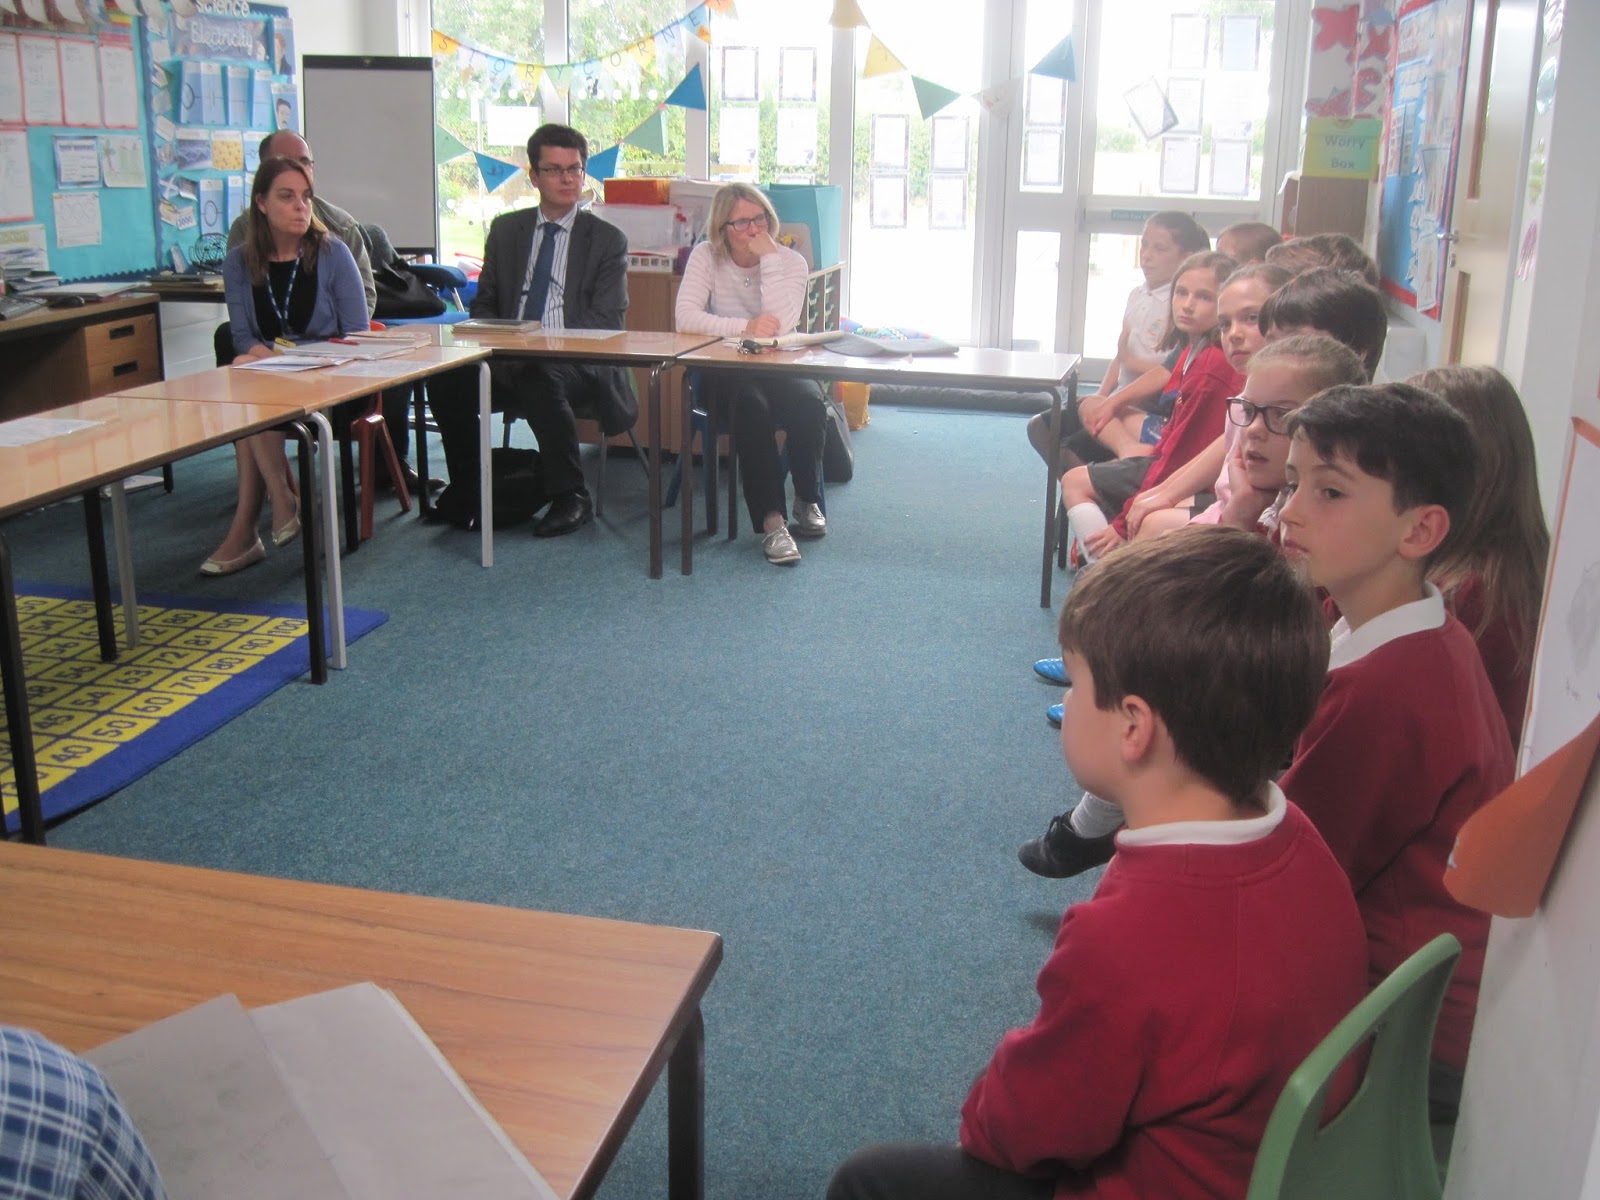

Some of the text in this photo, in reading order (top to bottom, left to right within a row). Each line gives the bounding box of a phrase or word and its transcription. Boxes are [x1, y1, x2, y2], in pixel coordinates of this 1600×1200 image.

[190, 20, 254, 56] Electricity
[583, 0, 722, 76] CORNE
[1324, 135, 1367, 151] Worry
[1331, 158, 1354, 169] Box
[238, 638, 274, 651] 90
[148, 651, 190, 665] 72
[206, 657, 245, 670] 80
[113, 669, 153, 685] 63
[169, 675, 211, 690] 70
[69, 690, 116, 707] 54
[133, 696, 174, 713] 60
[34, 713, 75, 729] 45
[91, 719, 138, 738] 50
[51, 744, 93, 763] 40
